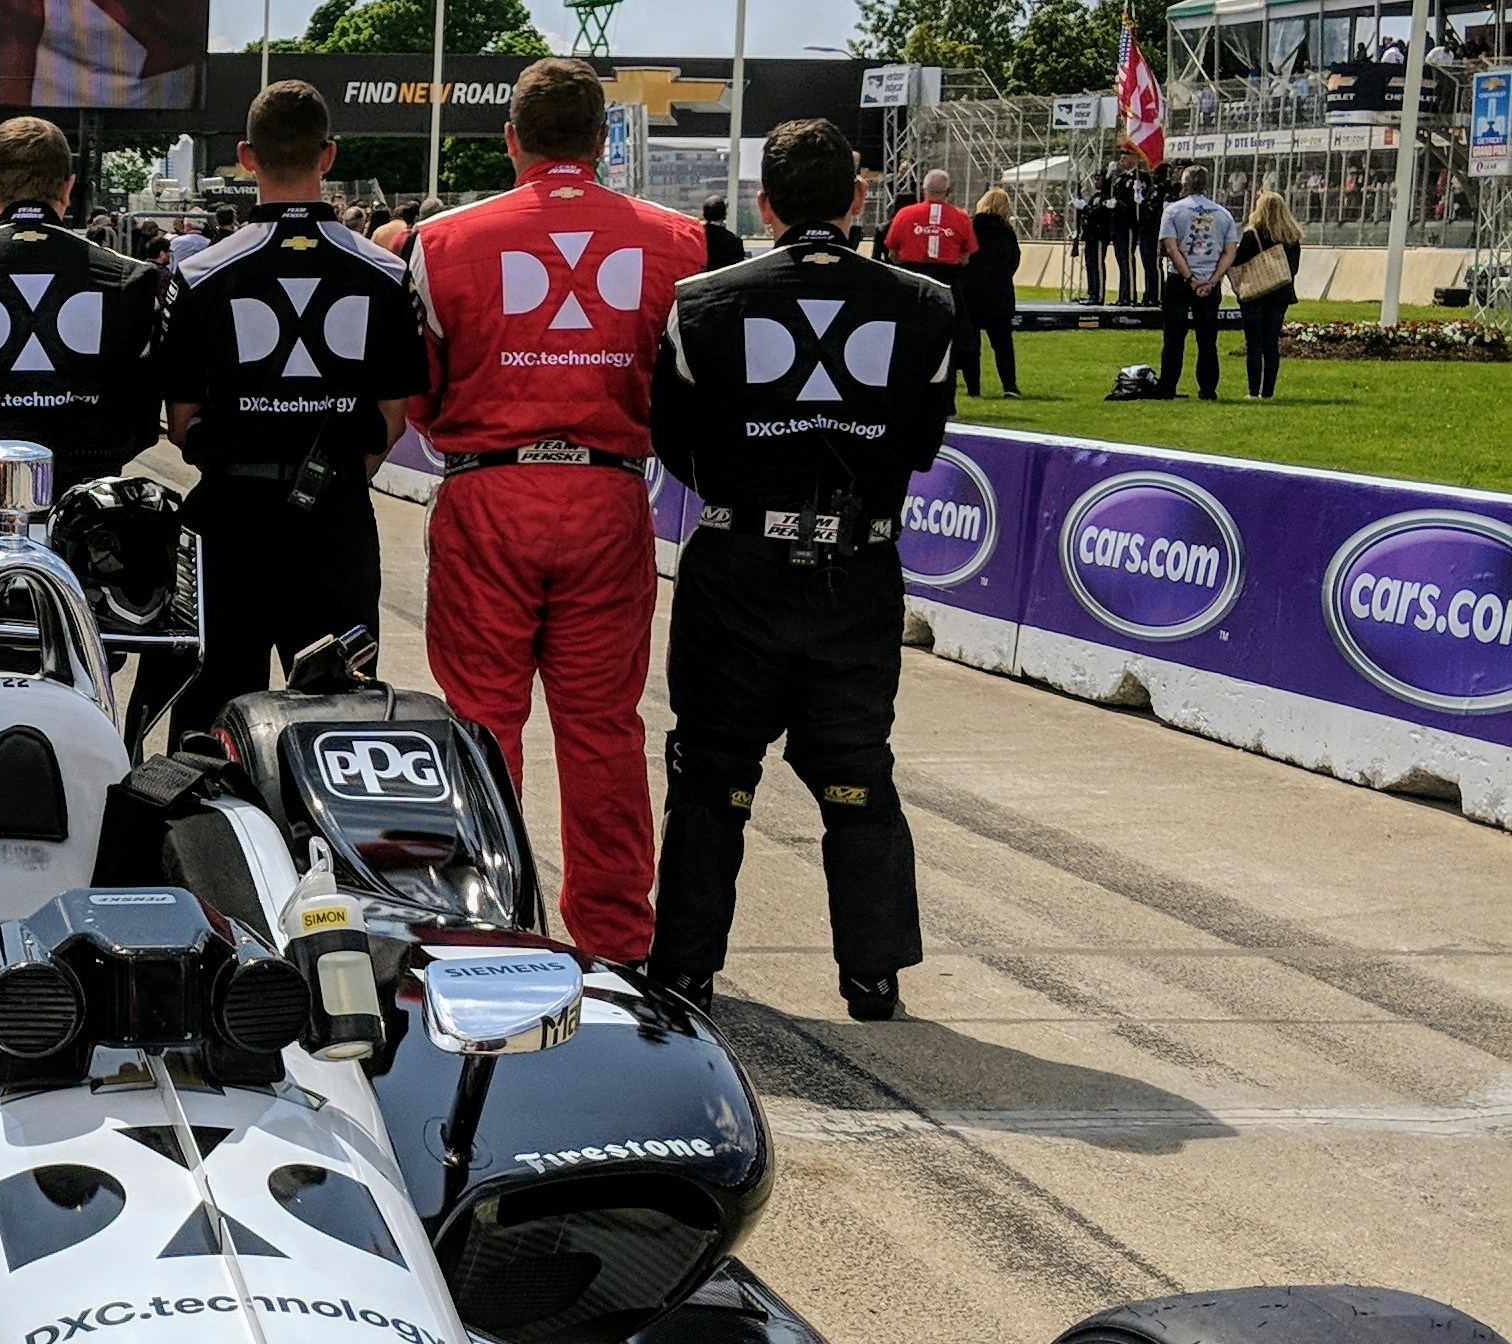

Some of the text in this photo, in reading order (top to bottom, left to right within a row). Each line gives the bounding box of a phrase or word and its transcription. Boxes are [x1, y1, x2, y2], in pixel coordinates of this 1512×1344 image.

[344, 82, 397, 104] FIND
[398, 82, 452, 104] NEW
[1234, 138, 1248, 149] DTE
[500, 350, 635, 368] DXC.technology
[535, 441, 579, 450] TEAM
[521, 452, 585, 463] PENSKE
[782, 515, 833, 528] TEM
[1079, 525, 1220, 588] cars.com
[324, 741, 439, 794] PPG
[304, 911, 345, 926] SIMON
[445, 962, 566, 978] SIEMENS
[515, 1138, 715, 1175] Firestone
